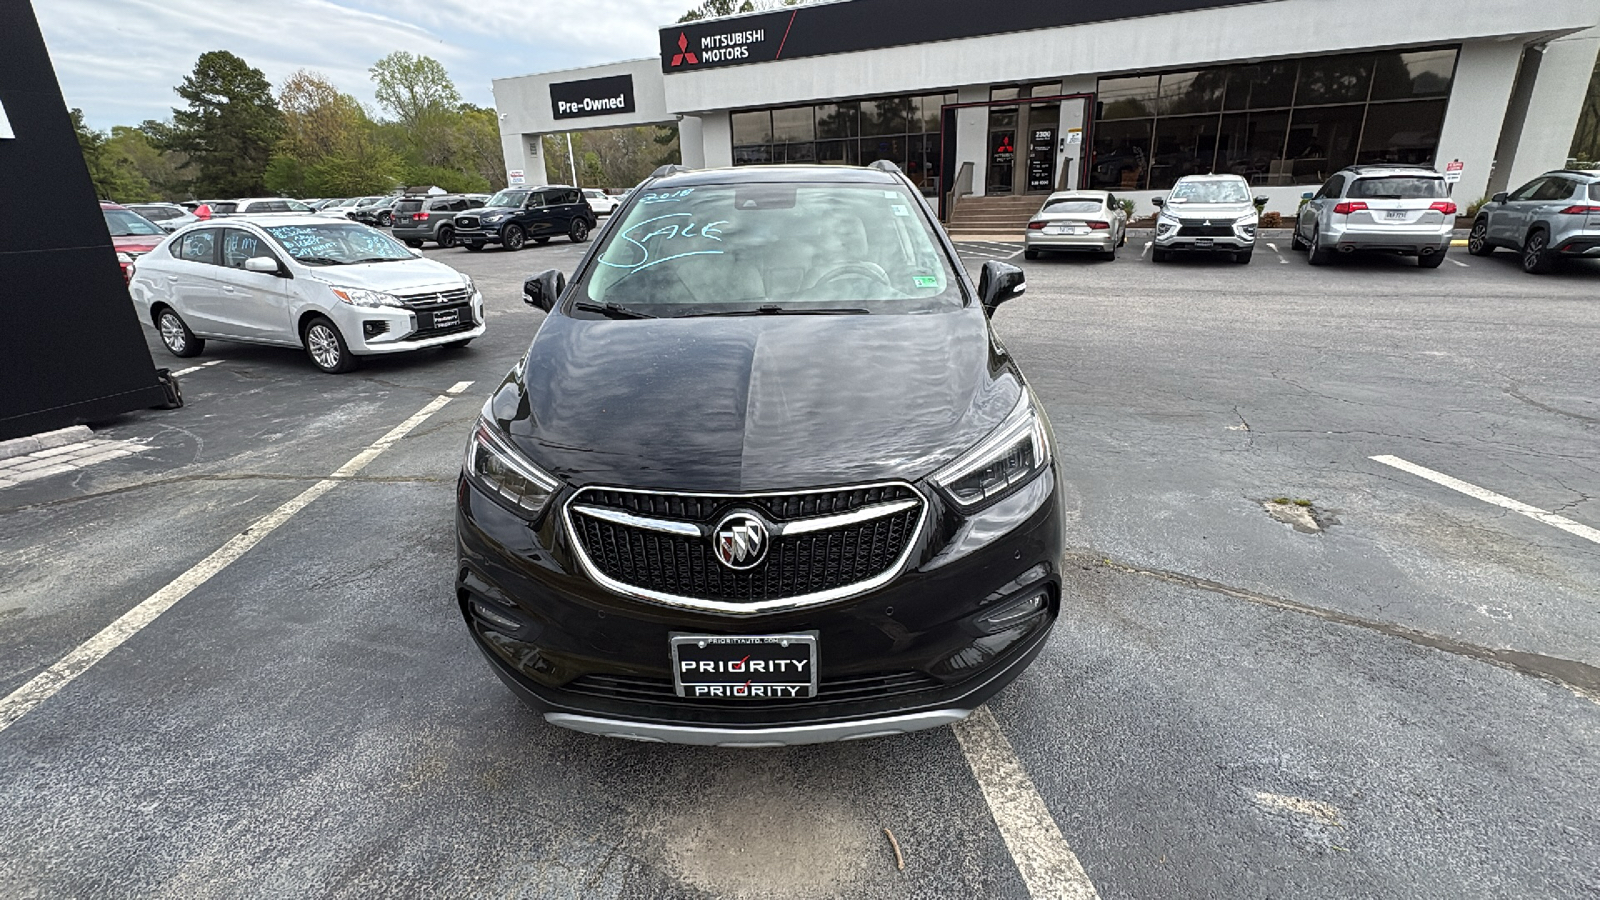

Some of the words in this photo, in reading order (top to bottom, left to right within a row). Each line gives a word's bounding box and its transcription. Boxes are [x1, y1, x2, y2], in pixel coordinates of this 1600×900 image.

[701, 29, 765, 49] MITSUBISHI
[702, 46, 749, 63] MOTORS
[558, 93, 625, 114] Pre-Owned
[597, 213, 729, 268] SALE
[708, 637, 779, 645] PRIORITYAUTO.COM
[681, 659, 808, 673] PRIORITY
[695, 685, 801, 697] PRIORITY
